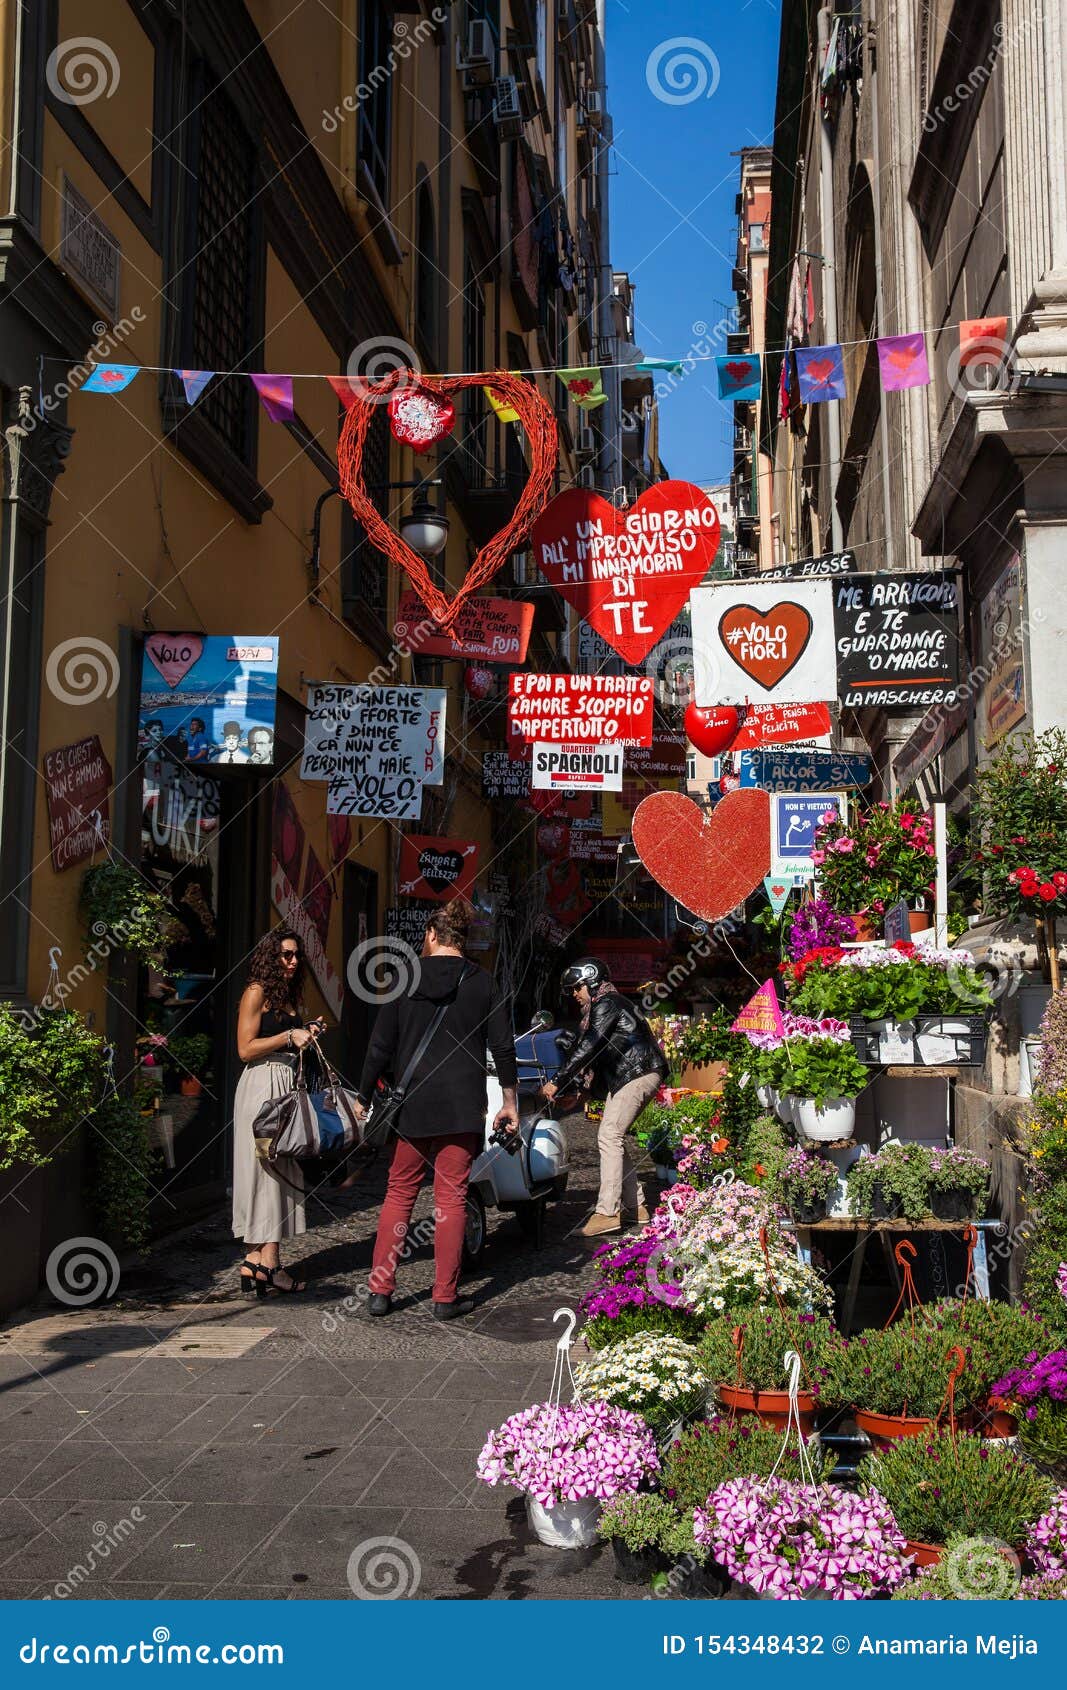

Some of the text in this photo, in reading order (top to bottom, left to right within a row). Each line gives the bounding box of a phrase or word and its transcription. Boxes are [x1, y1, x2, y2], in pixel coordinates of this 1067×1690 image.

[576, 507, 716, 539] UN GIORNO
[577, 528, 697, 560] IMPROVVISO
[563, 553, 683, 582] MI INNAMORAI
[801, 555, 851, 576] FUSSE
[612, 575, 635, 597] DI
[838, 586, 864, 611] ME
[602, 601, 653, 635] TE
[855, 609, 908, 633] E TE
[726, 622, 788, 645] #VOLO
[151, 645, 192, 664] VOLO
[740, 641, 787, 660] FIORI
[513, 674, 651, 694] E POI A UN TRATTO
[314, 688, 423, 708] ASTRIGNEME
[845, 689, 957, 707] LA MASCHERA
[360, 708, 422, 725] FFORTE
[765, 712, 776, 722] CE
[335, 723, 400, 740] E DIMME
[511, 717, 619, 739] DAPPERTUTTO
[345, 739, 374, 752] NUN
[378, 739, 403, 751] CE
[424, 711, 441, 772] FOJA
[561, 745, 596, 754] QUARTIERI
[536, 752, 619, 774] SPAGNOLI
[741, 754, 760, 765] SO
[749, 765, 849, 780] E ALLOR SI
[328, 774, 416, 799] #VOLO
[337, 796, 418, 817] FIORI
[785, 803, 798, 811] NON
[807, 802, 832, 811] VIETATO
